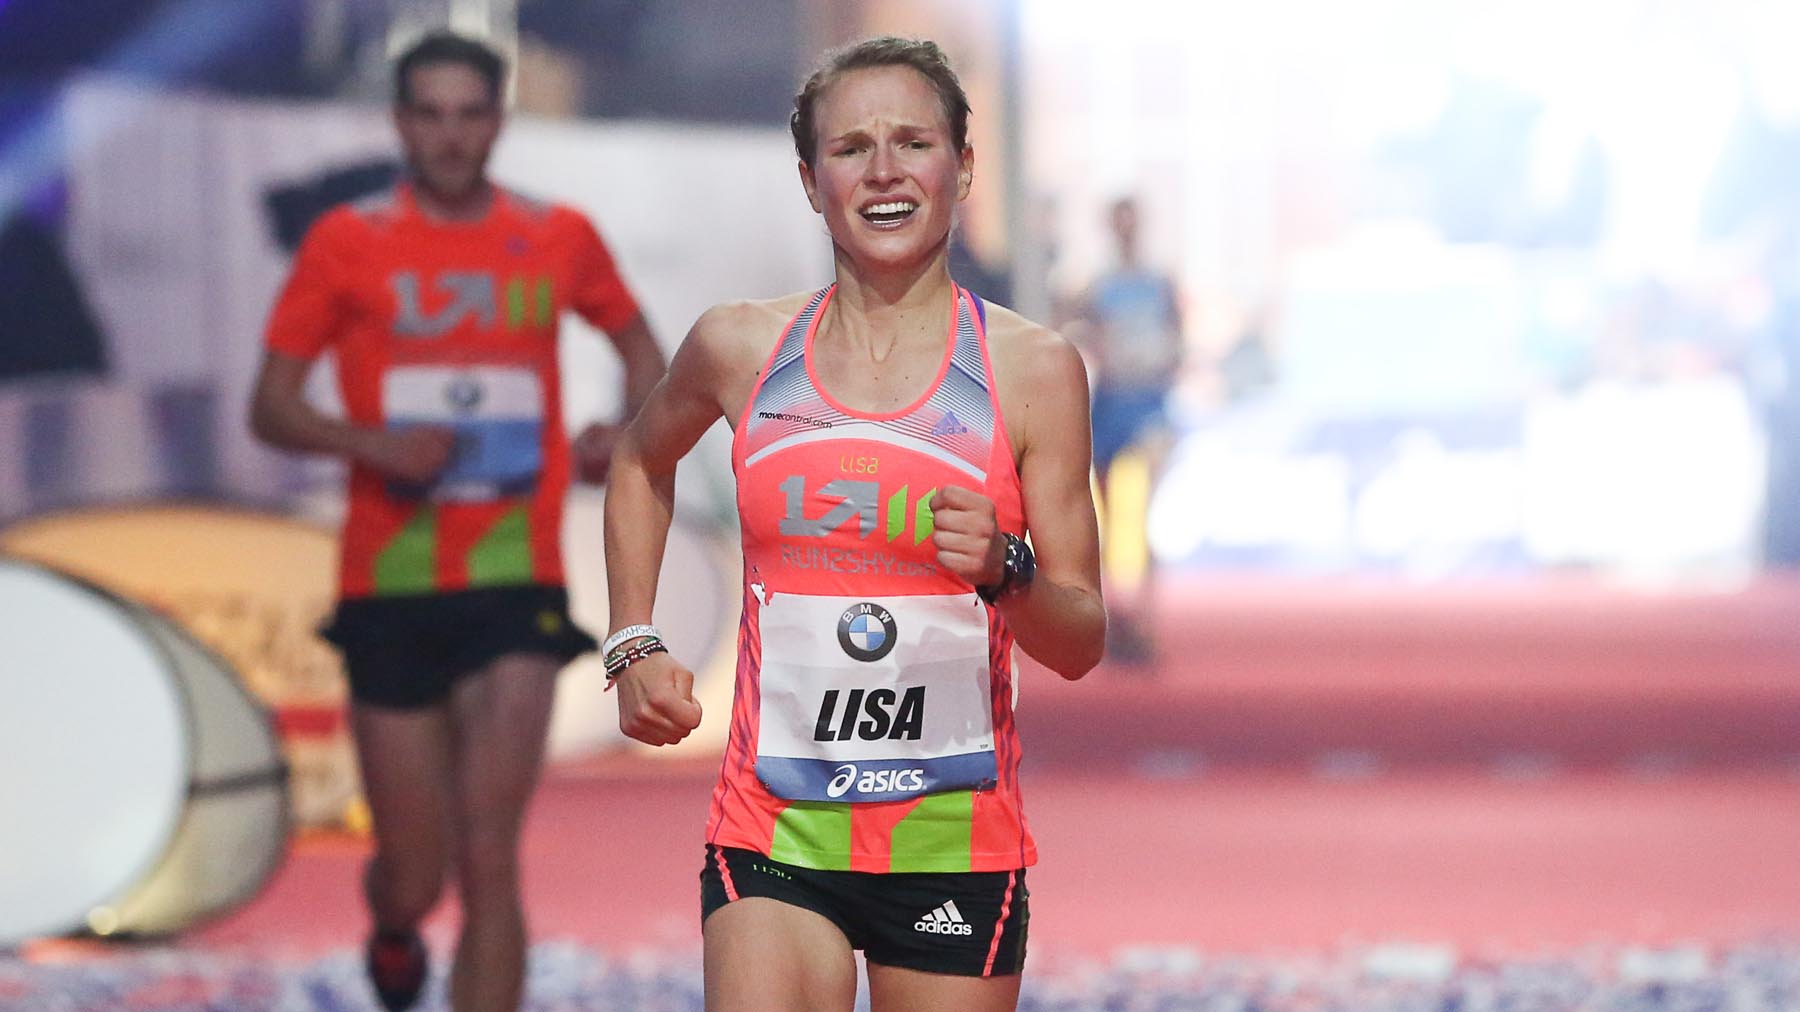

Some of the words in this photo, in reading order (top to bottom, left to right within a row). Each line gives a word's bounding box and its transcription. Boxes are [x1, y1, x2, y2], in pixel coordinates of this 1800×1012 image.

[842, 604, 892, 624] BMW
[814, 686, 926, 742] LISA
[857, 769, 923, 793] asics
[914, 919, 973, 936] adidas
